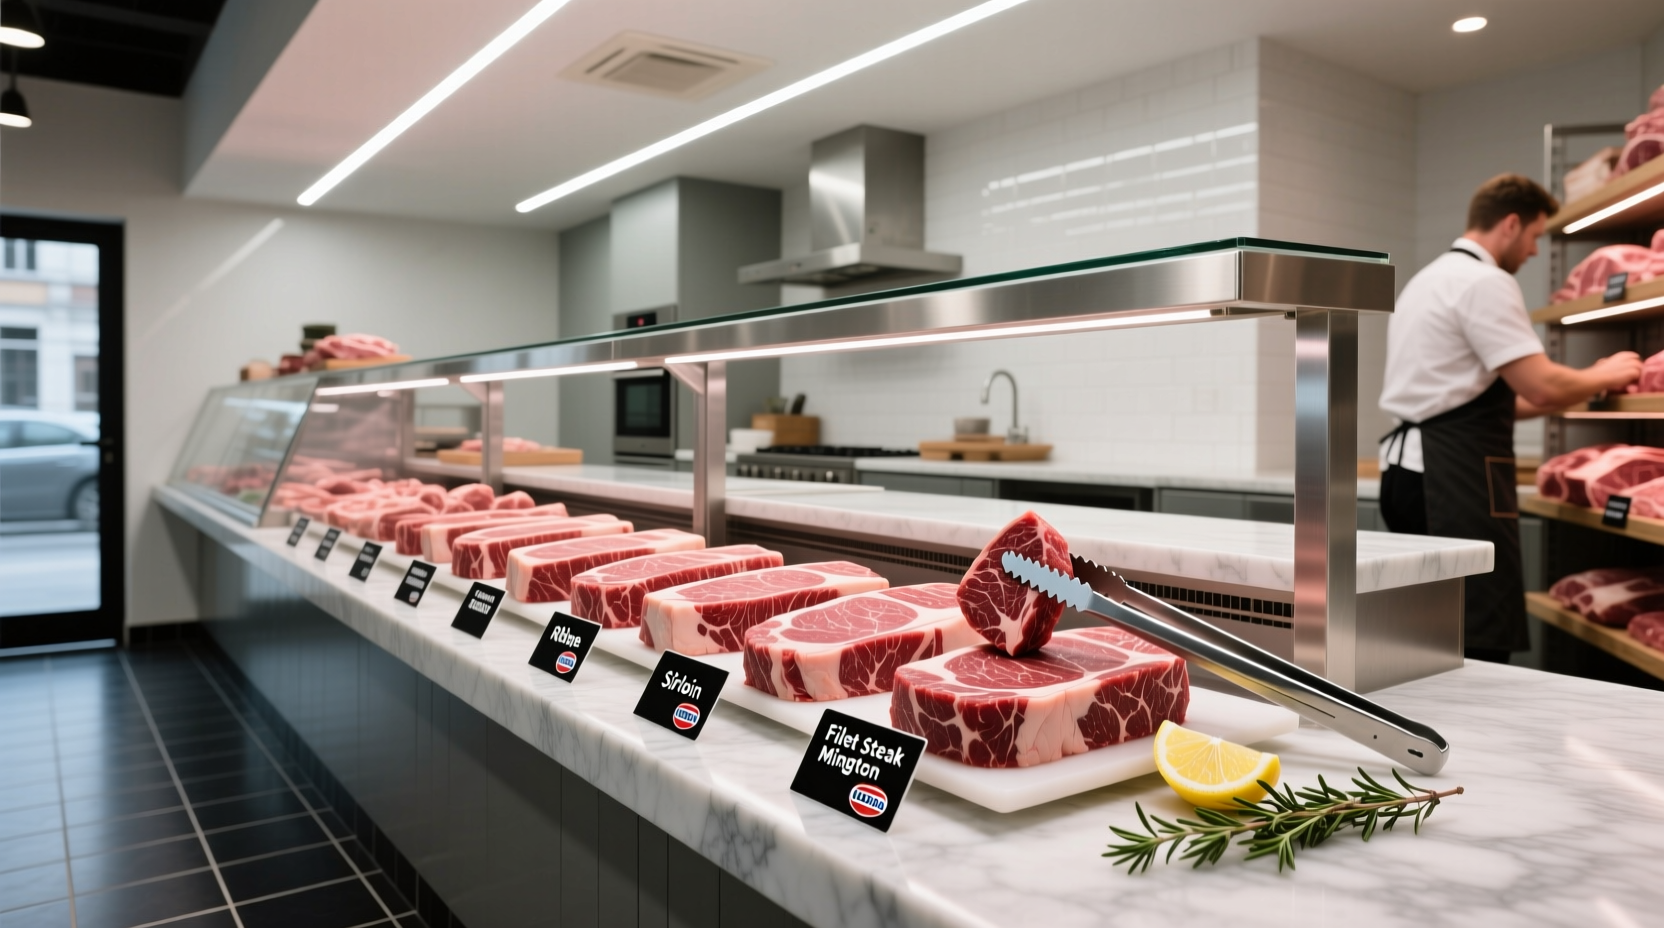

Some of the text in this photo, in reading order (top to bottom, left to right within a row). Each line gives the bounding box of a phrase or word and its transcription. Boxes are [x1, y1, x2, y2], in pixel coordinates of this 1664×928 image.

[817, 745, 880, 781] Mington
[825, 724, 905, 768] Filet Steak
